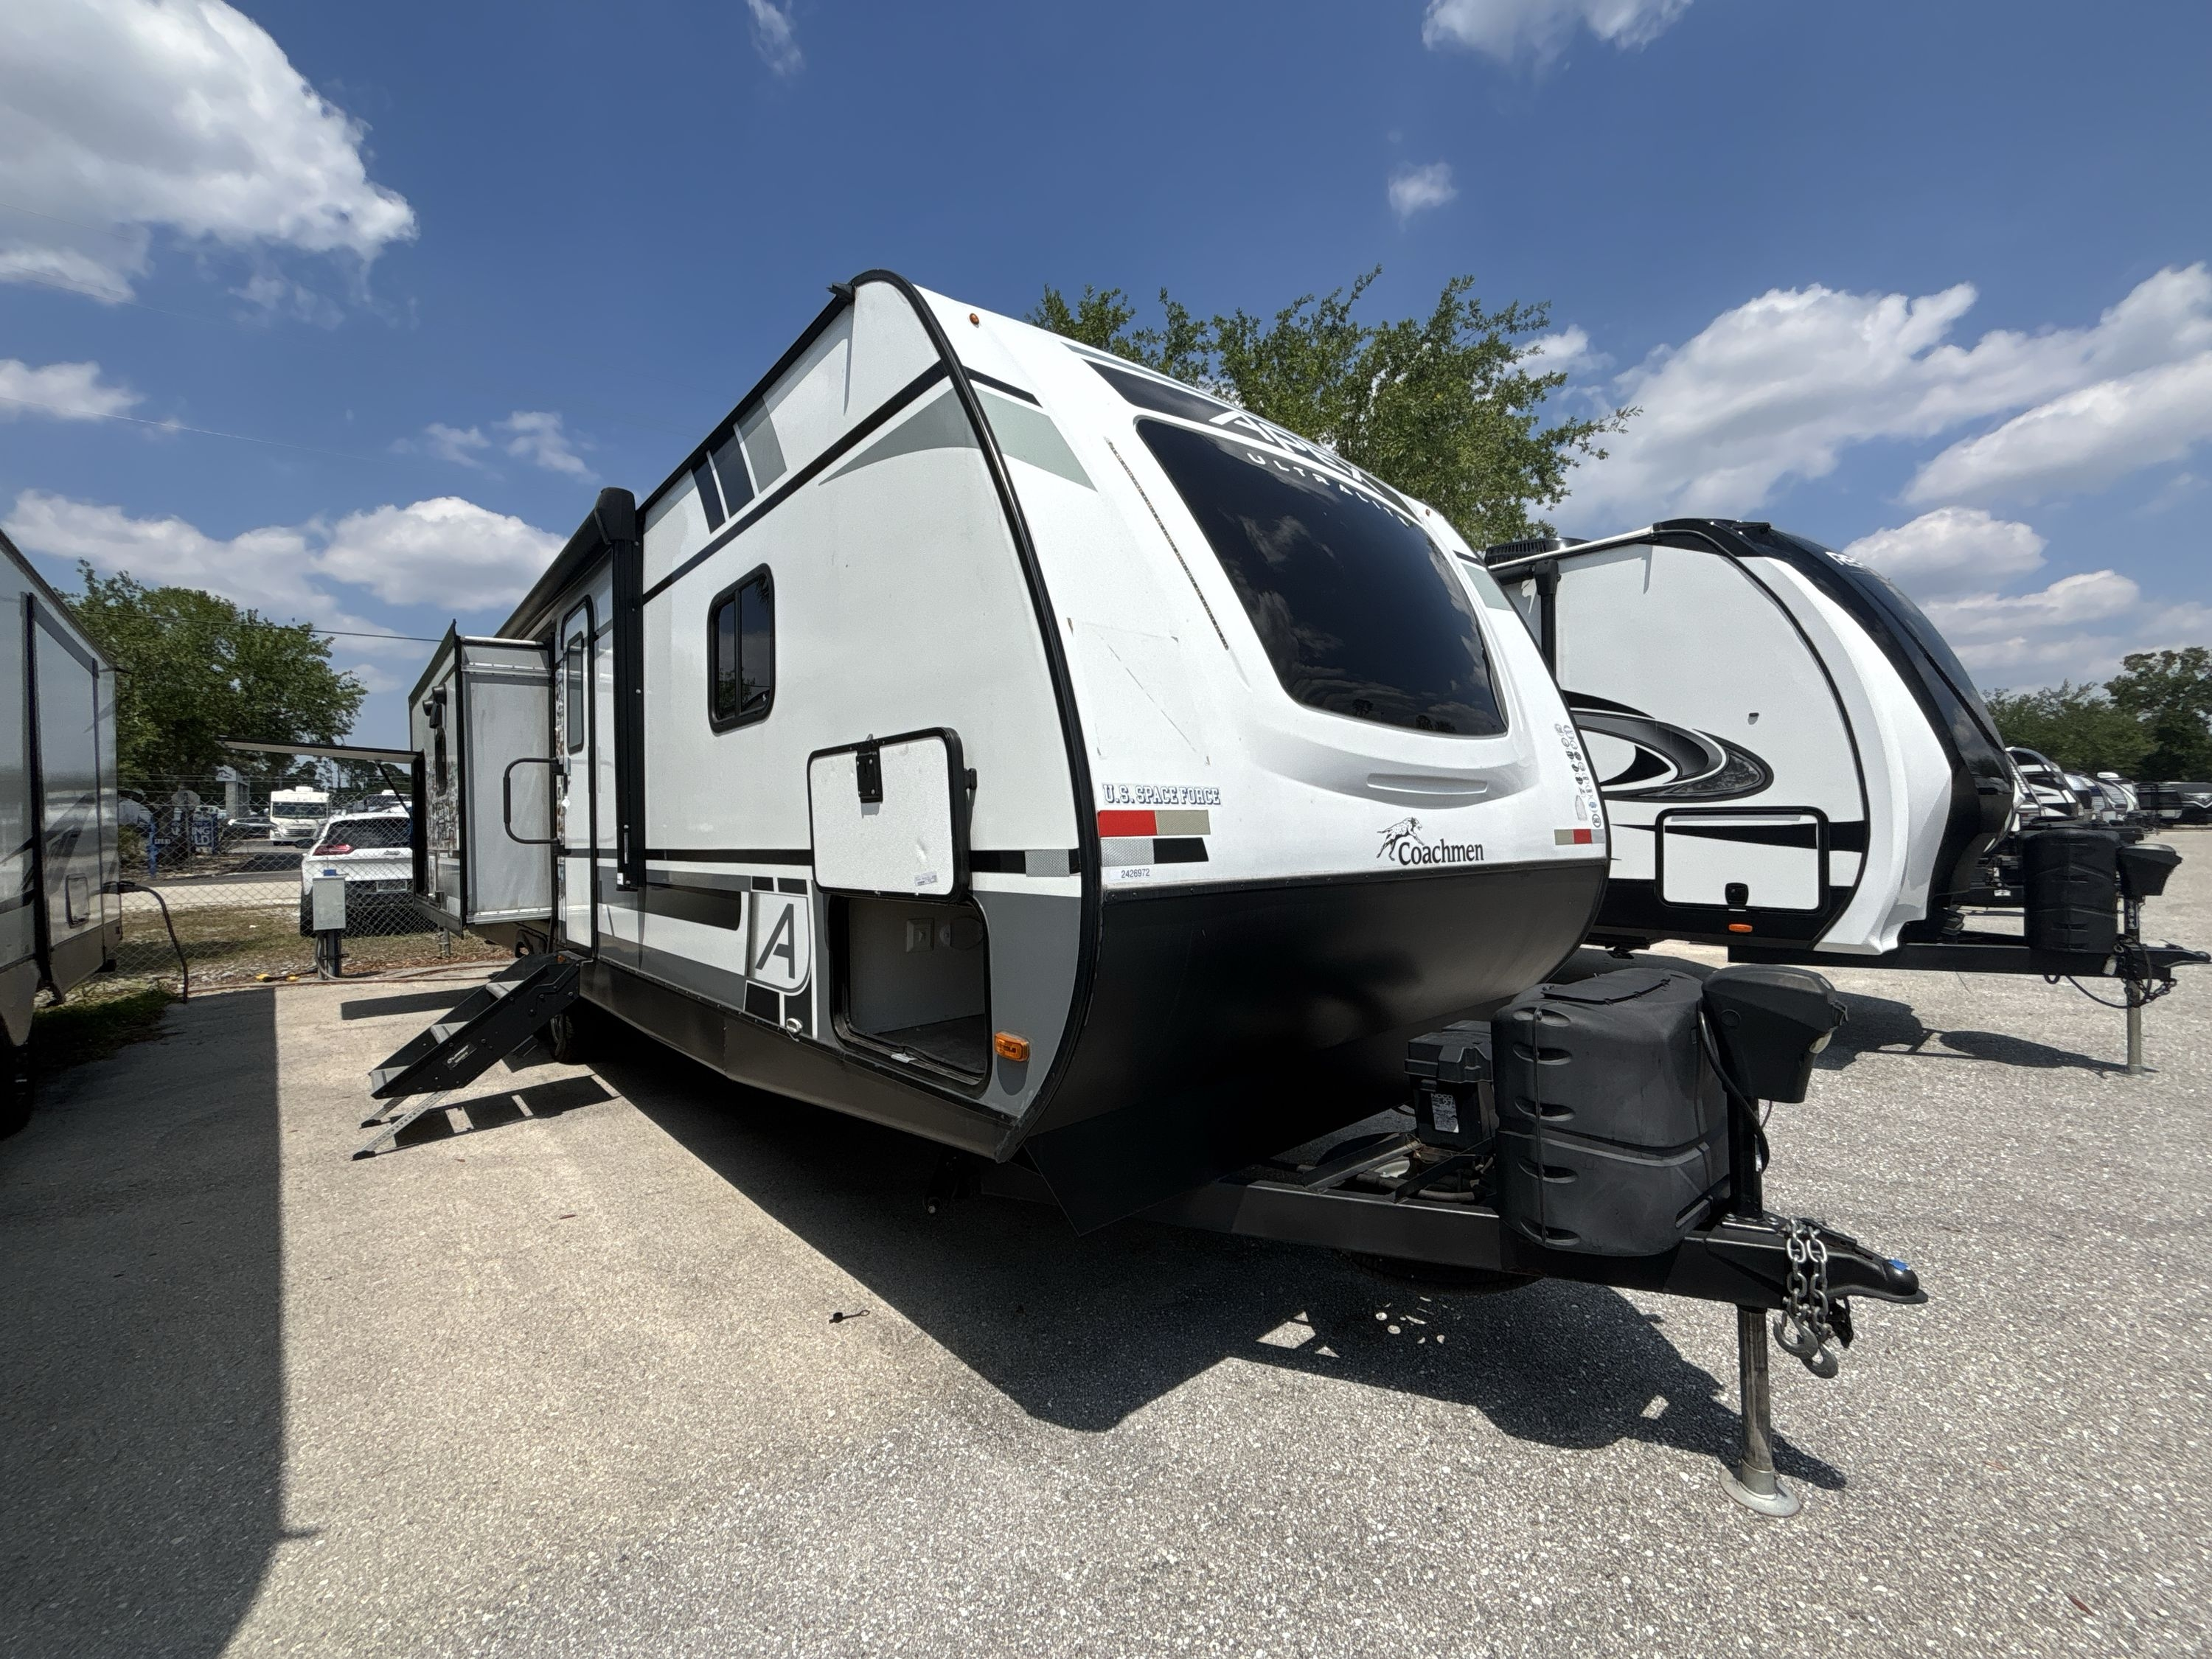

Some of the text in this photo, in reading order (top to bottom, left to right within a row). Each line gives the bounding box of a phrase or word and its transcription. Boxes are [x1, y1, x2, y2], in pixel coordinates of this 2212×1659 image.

[1102, 784, 1221, 805] U.S. SPACE FORCE
[1398, 838, 1484, 866] Coachmen
[1121, 868, 1150, 879] 2426972
[755, 903, 796, 979] A
[1430, 1092, 1453, 1100] NOCO
